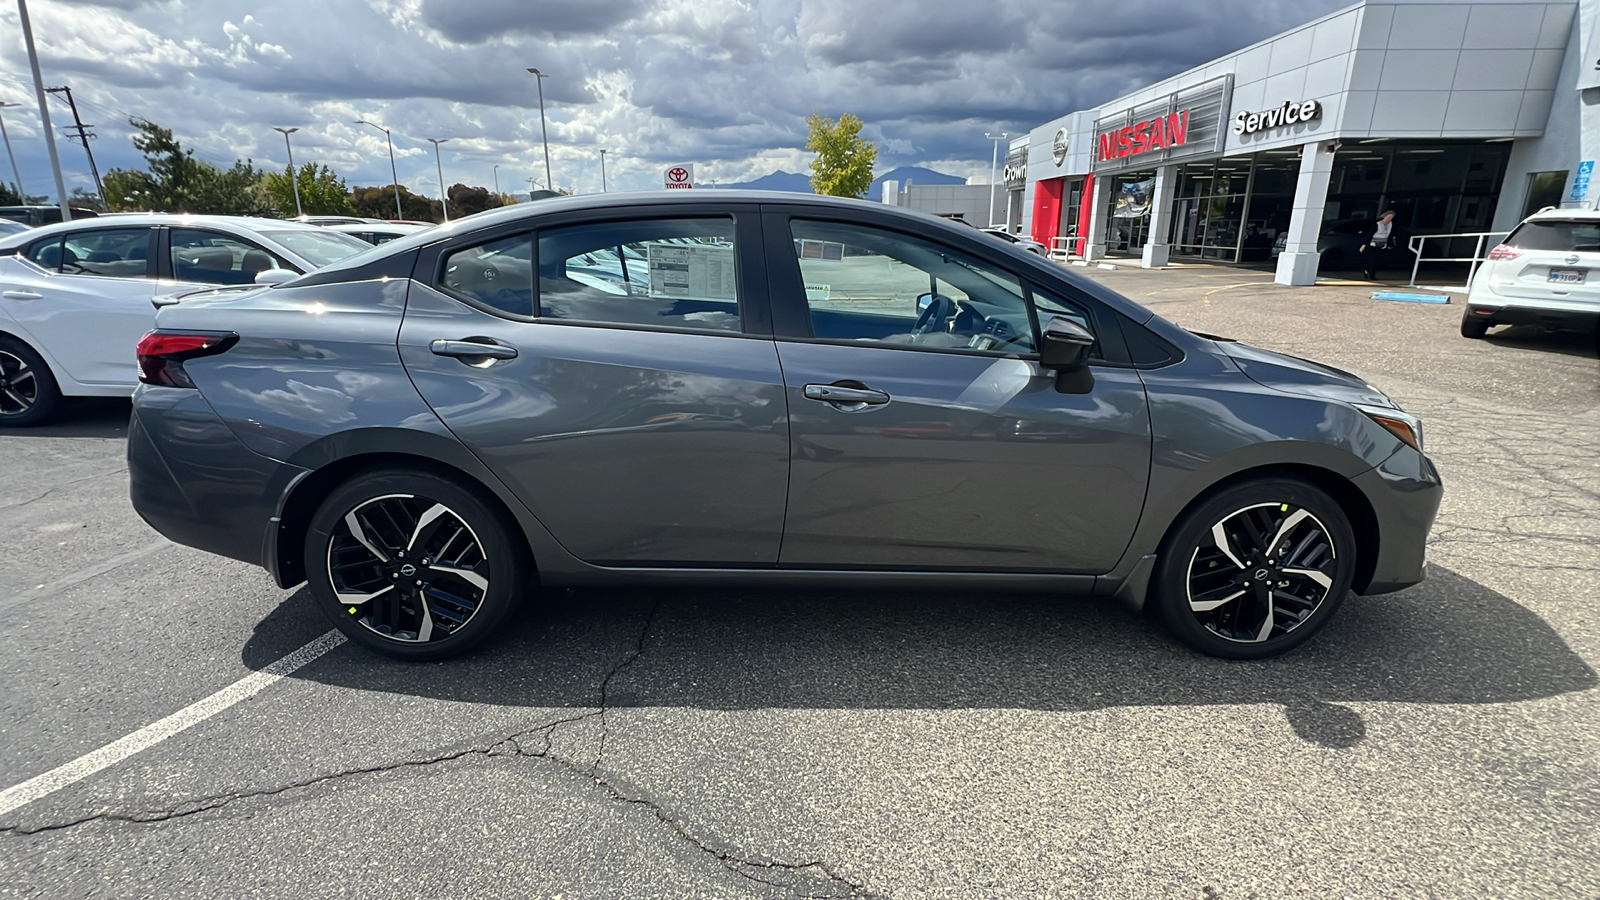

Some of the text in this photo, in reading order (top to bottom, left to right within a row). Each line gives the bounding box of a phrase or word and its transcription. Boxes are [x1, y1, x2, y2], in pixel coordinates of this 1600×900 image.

[1098, 109, 1189, 162] NISSAN
[1232, 100, 1319, 136] Service
[1003, 164, 1027, 182] Crown
